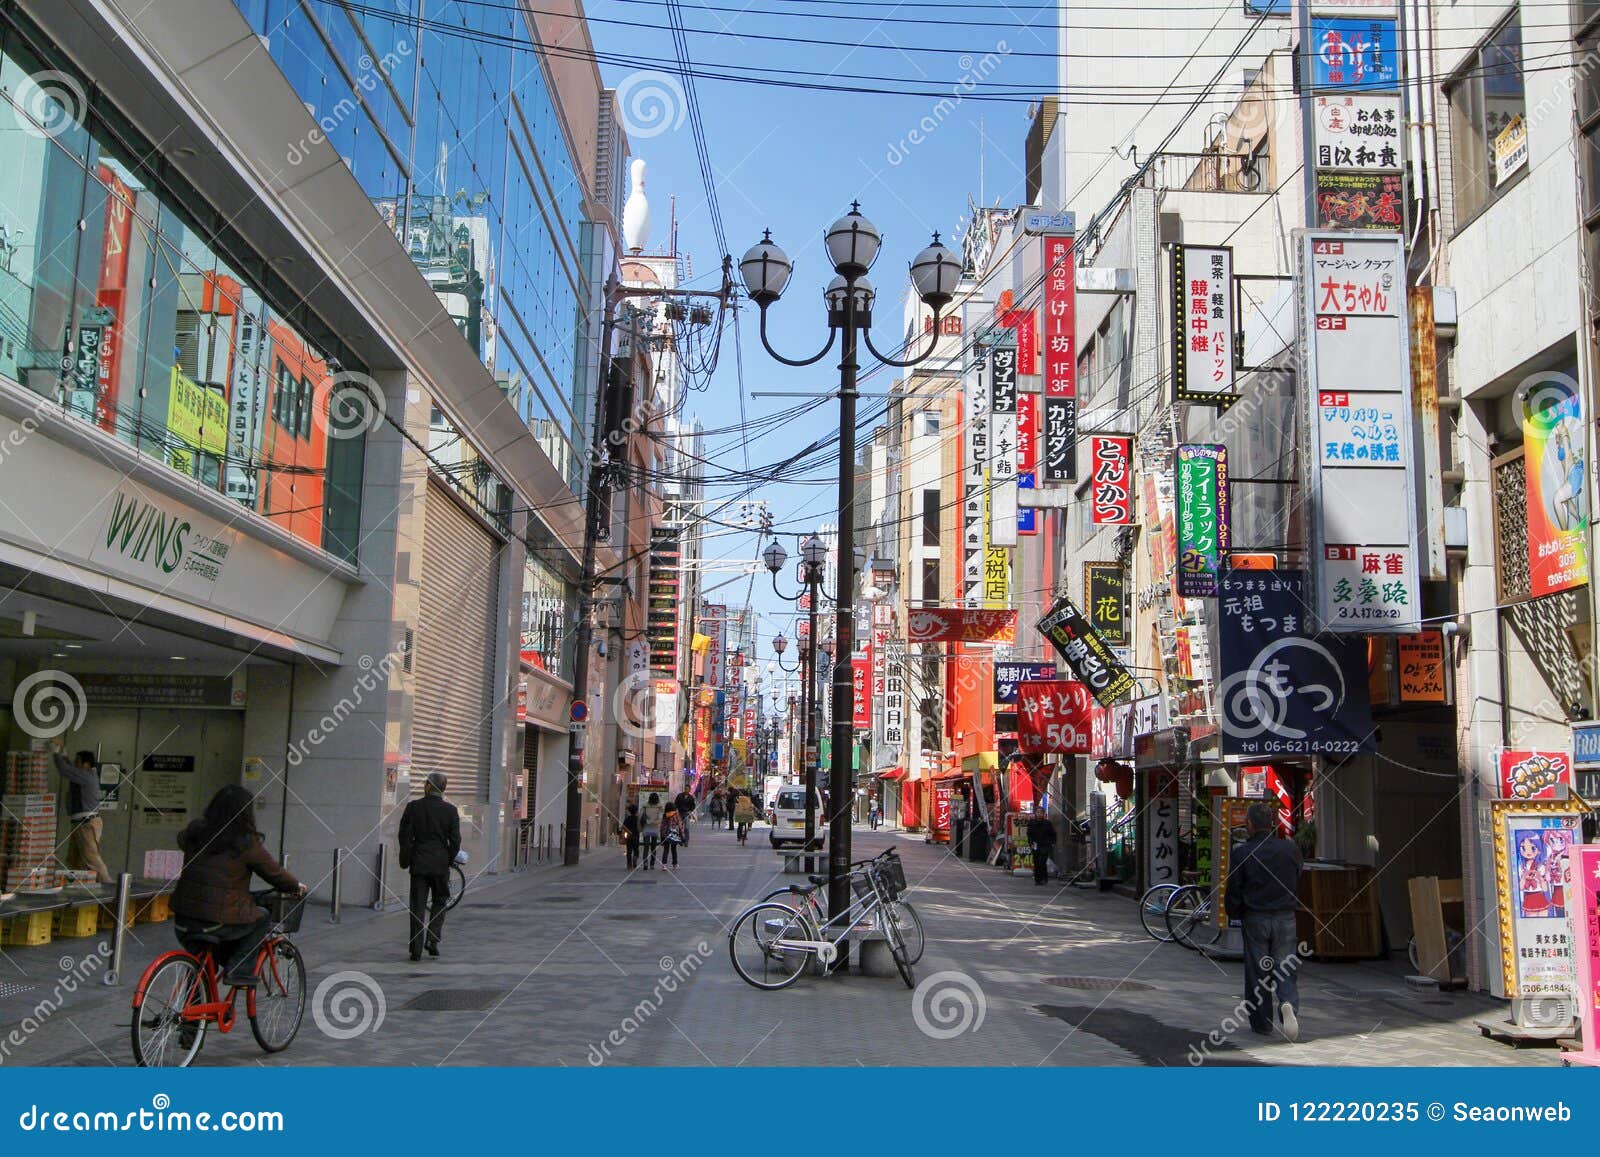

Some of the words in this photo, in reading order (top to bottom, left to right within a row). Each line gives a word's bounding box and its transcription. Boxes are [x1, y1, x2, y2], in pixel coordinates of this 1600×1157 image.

[1357, 108, 1395, 122] お食事
[1320, 146, 1331, 165] 2F
[1335, 145, 1397, 167] 以和貴
[1317, 243, 1340, 254] 4F
[1316, 259, 1361, 270] マージャン
[1364, 259, 1395, 270] クラブ
[1211, 254, 1224, 319] 喫茶・軽食
[1319, 275, 1388, 312] 大ちゃん
[1051, 300, 1068, 352] けー坊
[1191, 280, 1208, 352] 競馬中継
[1318, 318, 1343, 329] 3F
[1212, 332, 1225, 382] パドック
[1053, 364, 1069, 375] 1F
[1052, 379, 1069, 392] 3F
[1321, 395, 1346, 406] 2F
[1323, 408, 1393, 423] デリバリー
[1048, 405, 1067, 468] カルダン
[1351, 425, 1399, 442] ヘルス
[1325, 443, 1400, 462] 天使の誘惑
[1054, 470, 1067, 479] B1
[1095, 438, 1127, 523] とんかつ
[1182, 463, 1195, 542] リラクゼーション
[1195, 462, 1214, 552] ライ・ラック
[107, 491, 192, 573] WINS
[1182, 551, 1206, 571] 2F
[1328, 549, 1353, 560] B1
[1362, 554, 1405, 575] 麻雀
[1223, 580, 1266, 591] もつまる
[1095, 597, 1120, 622] 花
[1224, 595, 1265, 616] 元祖
[996, 667, 1040, 682] 焼酎バー
[1264, 658, 1335, 713] もつ
[1022, 688, 1088, 722] やきとり
[1024, 733, 1042, 746] 1本
[1046, 723, 1088, 749] 50円
[1241, 741, 1258, 752] tel
[1264, 741, 1360, 752] 06-6214-0222
[937, 800, 949, 828] ラーメン
[1155, 800, 1173, 880] とんかつ
[1535, 934, 1567, 944] 美女多数
